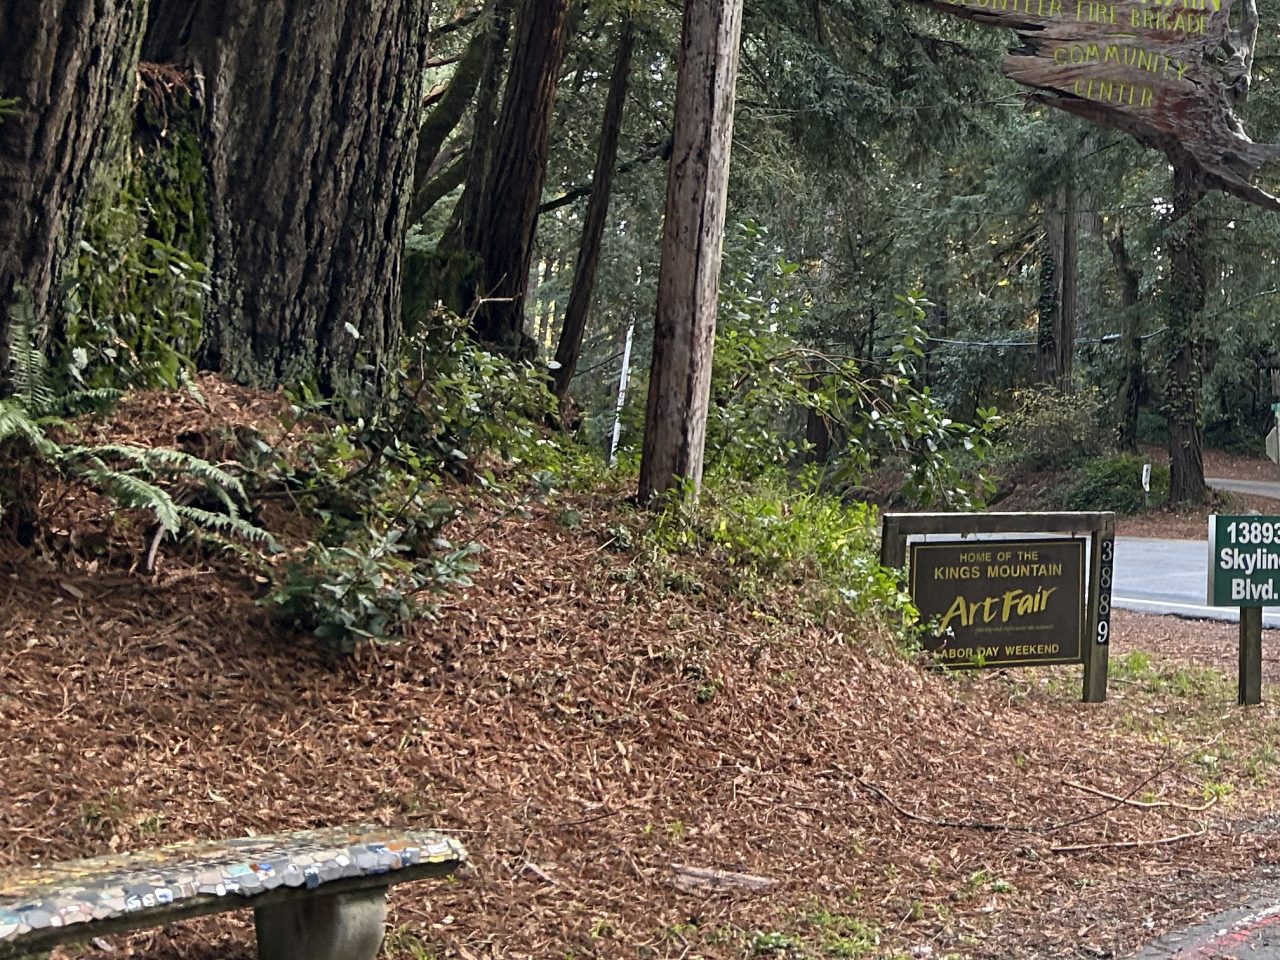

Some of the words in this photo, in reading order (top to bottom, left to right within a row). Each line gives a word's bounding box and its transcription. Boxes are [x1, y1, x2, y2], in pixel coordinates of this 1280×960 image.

[1077, 0, 1118, 25] FIRE
[1131, 8, 1209, 35] BRIGADE
[1054, 43, 1188, 81] COMMUNITY
[1074, 79, 1153, 107] CENTER
[960, 552, 992, 563] HOME
[997, 551, 1012, 562] OF
[1017, 550, 1039, 561] THE
[934, 566, 980, 580] KINGS
[987, 563, 1062, 579] MOUNTAIN
[1232, 579, 1279, 600] Blvd.
[938, 595, 1000, 637] Art
[1001, 586, 1057, 623] Fair
[978, 645, 1000, 657] DAY
[1005, 643, 1060, 655] WEEKEND
